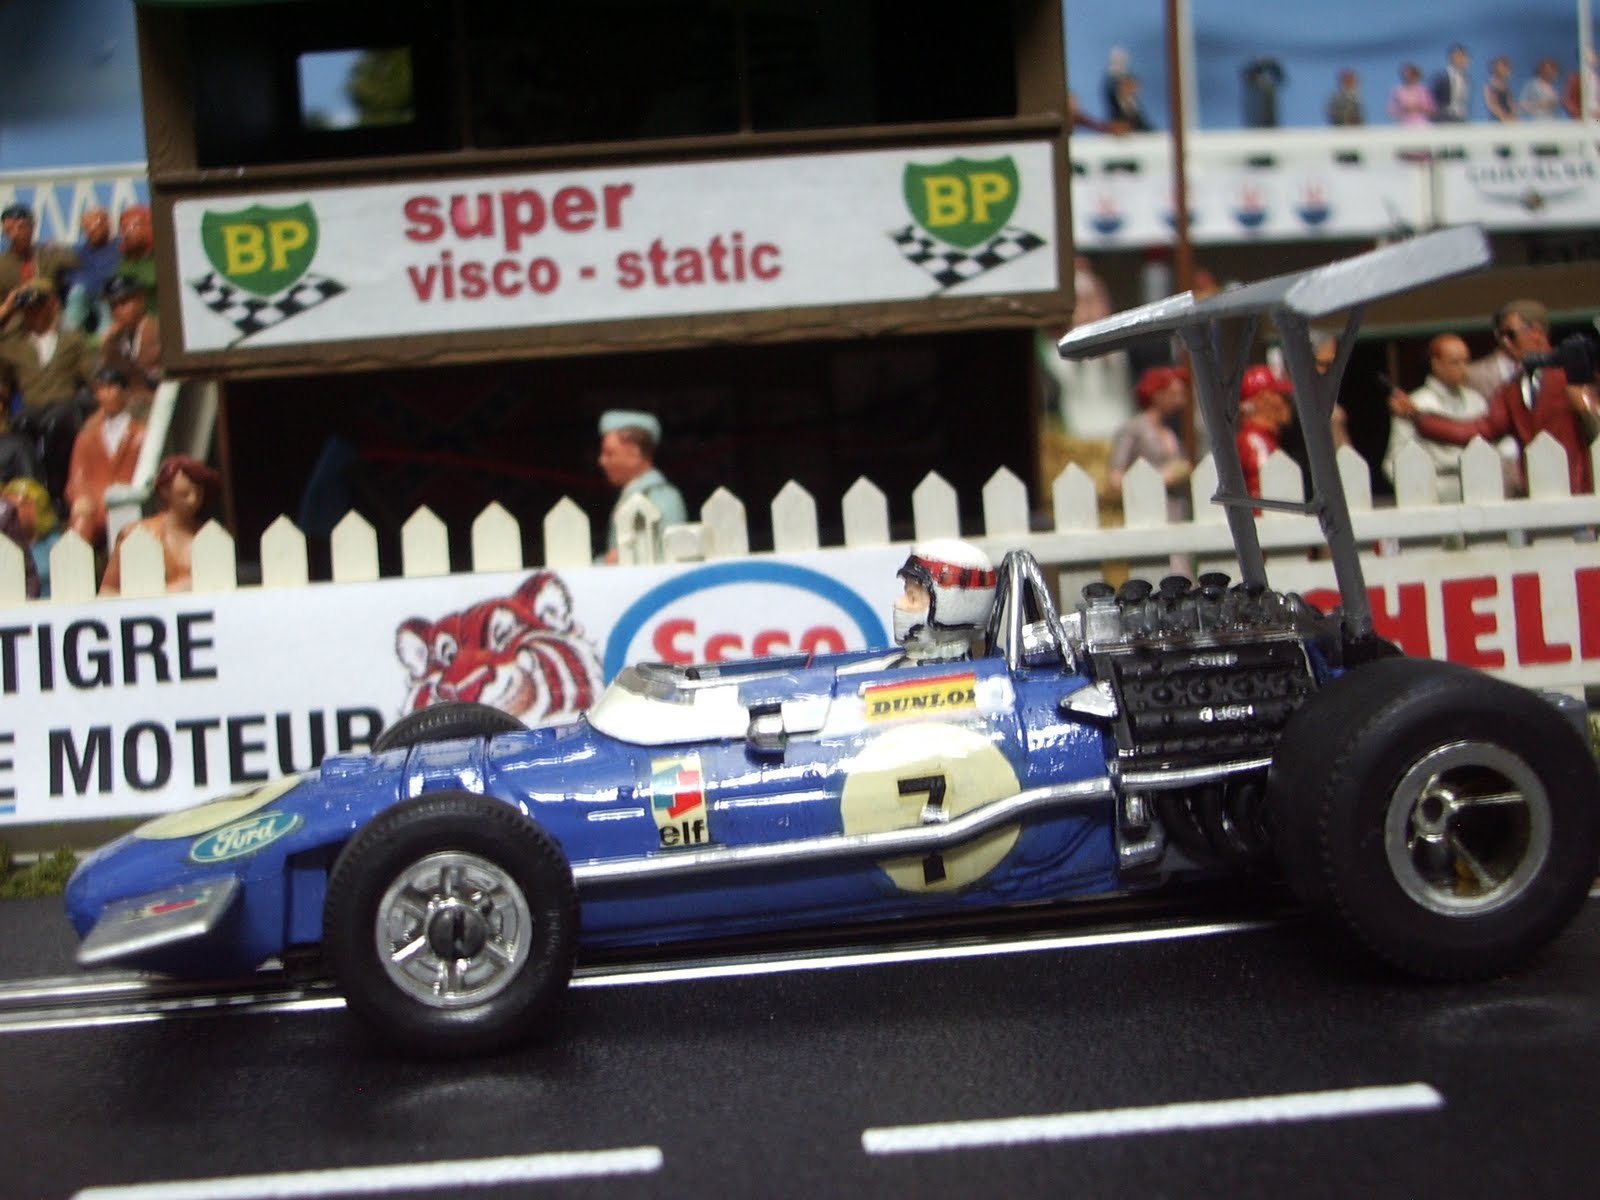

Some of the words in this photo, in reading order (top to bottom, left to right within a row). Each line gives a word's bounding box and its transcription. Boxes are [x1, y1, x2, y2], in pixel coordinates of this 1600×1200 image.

[404, 181, 634, 252] super
[922, 172, 1011, 227] BP
[220, 219, 310, 275] BP
[407, 250, 560, 302] visco
[616, 231, 783, 290] static
[0, 610, 218, 694] TIGRE
[1302, 566, 1600, 669] HEL
[212, 817, 277, 858] Ford
[659, 819, 705, 846] elf
[897, 774, 947, 885] 7
